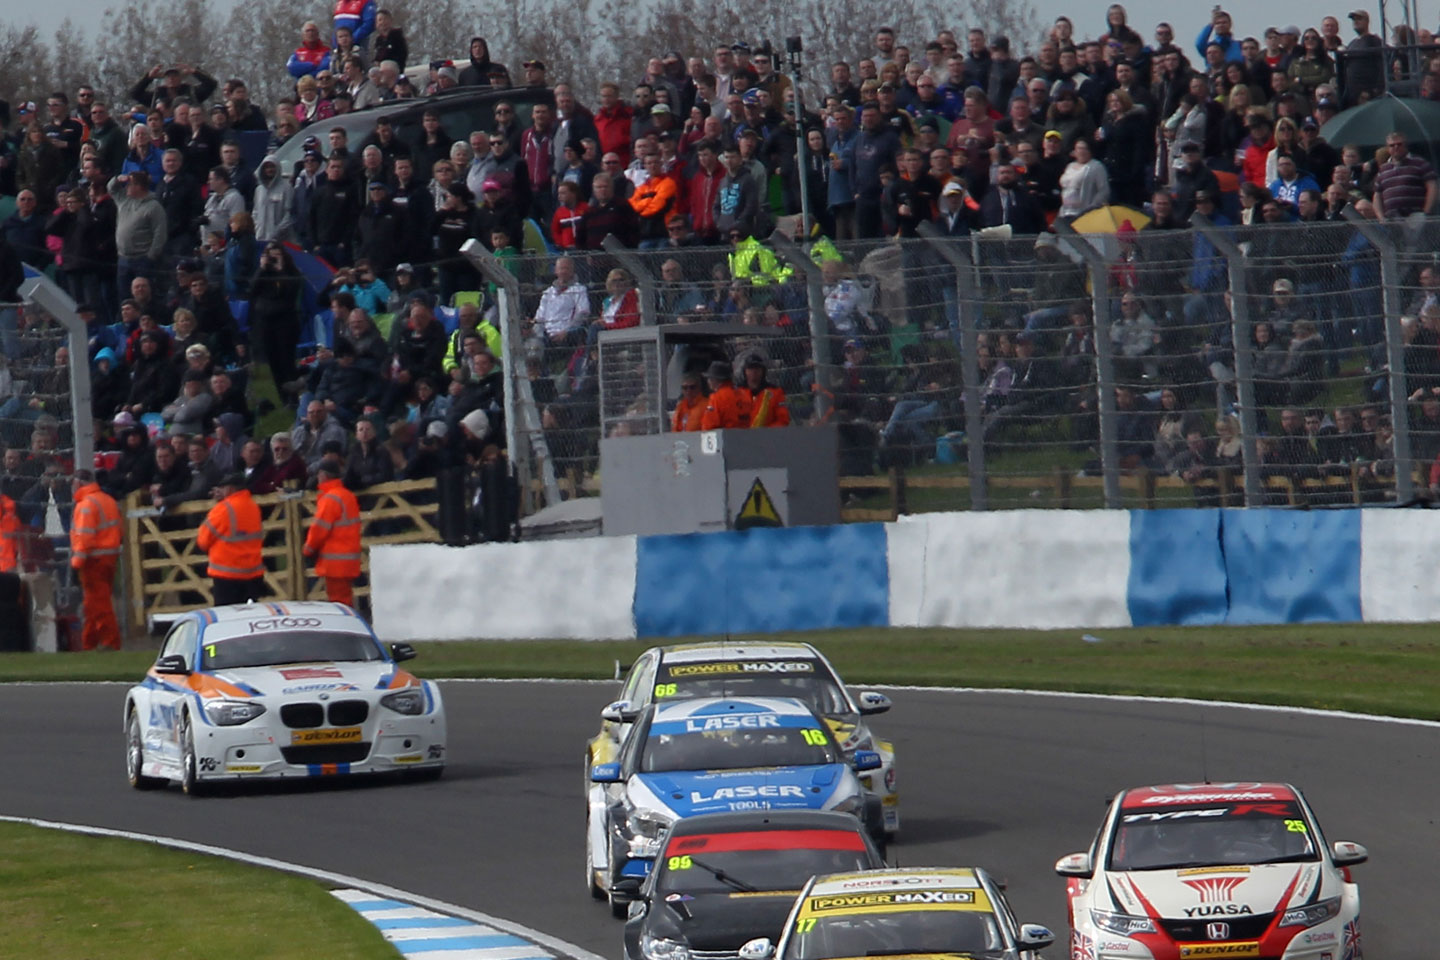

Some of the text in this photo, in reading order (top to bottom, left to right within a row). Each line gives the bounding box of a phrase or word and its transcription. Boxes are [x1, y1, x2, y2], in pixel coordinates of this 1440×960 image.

[248, 617, 322, 633] JCT600
[674, 662, 810, 676] POWER MAXED
[686, 714, 781, 733] LASER
[304, 730, 361, 742] DUNLOP
[800, 728, 829, 747] 16
[690, 785, 807, 804] LASER
[1123, 808, 1229, 823] TYPE
[1283, 819, 1307, 833] 25
[818, 891, 970, 910] POWER MAXED
[1184, 904, 1254, 918] YUASA
[1286, 912, 1305, 920] HiQ
[796, 918, 818, 934] 17
[1130, 921, 1149, 929] HiQ
[1193, 944, 1258, 955] DUNLOP
